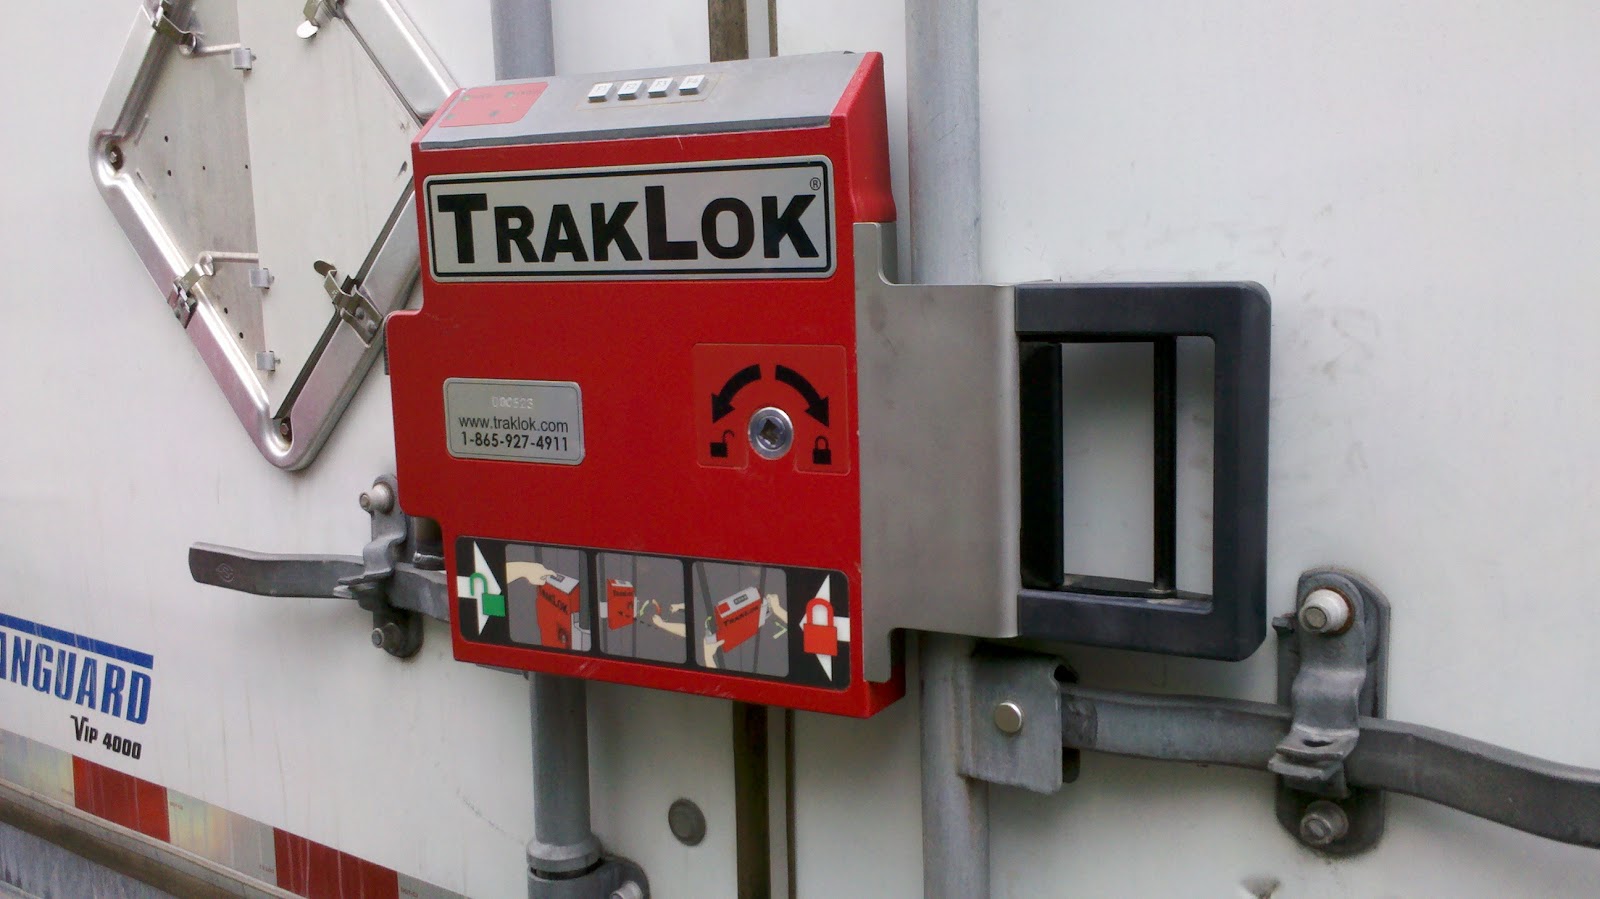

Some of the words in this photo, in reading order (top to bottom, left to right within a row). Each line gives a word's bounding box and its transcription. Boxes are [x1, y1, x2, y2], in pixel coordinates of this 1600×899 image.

[458, 416, 569, 433] www.traklok.com
[461, 431, 568, 451] 1-865-927-4911
[102, 732, 142, 760] 4000
